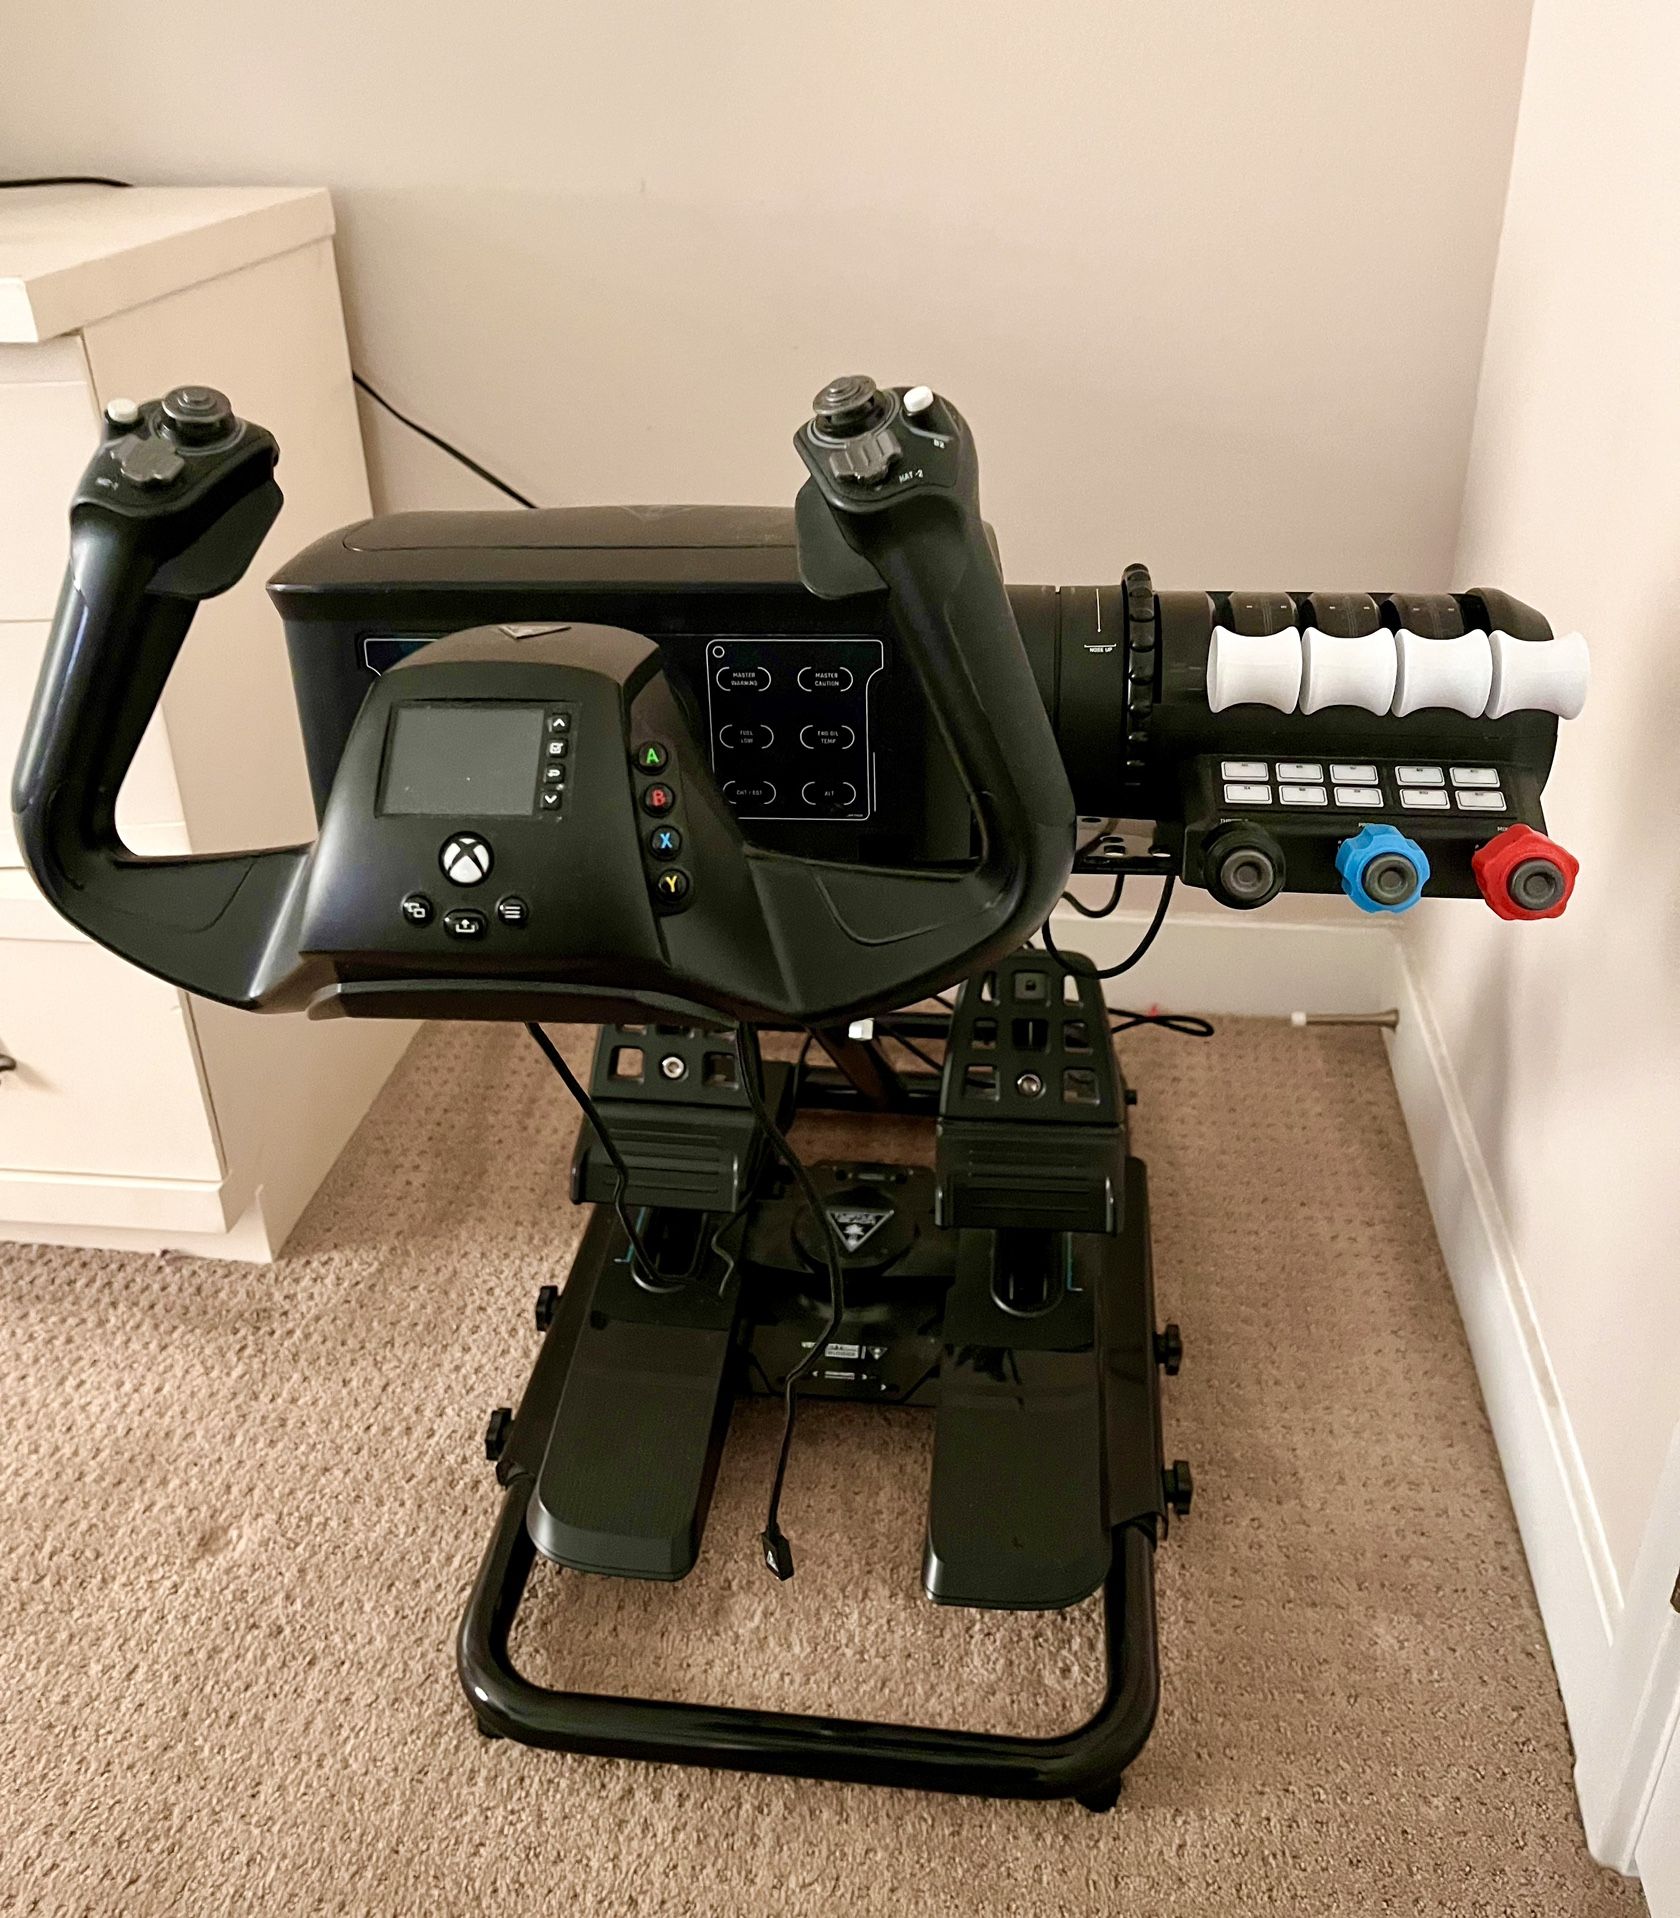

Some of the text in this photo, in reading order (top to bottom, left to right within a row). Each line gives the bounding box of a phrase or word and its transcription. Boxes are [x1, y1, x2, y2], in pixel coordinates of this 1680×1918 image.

[646, 747, 659, 764] A
[652, 789, 666, 806] B
[659, 832, 673, 849] X
[665, 875, 678, 893] Y
